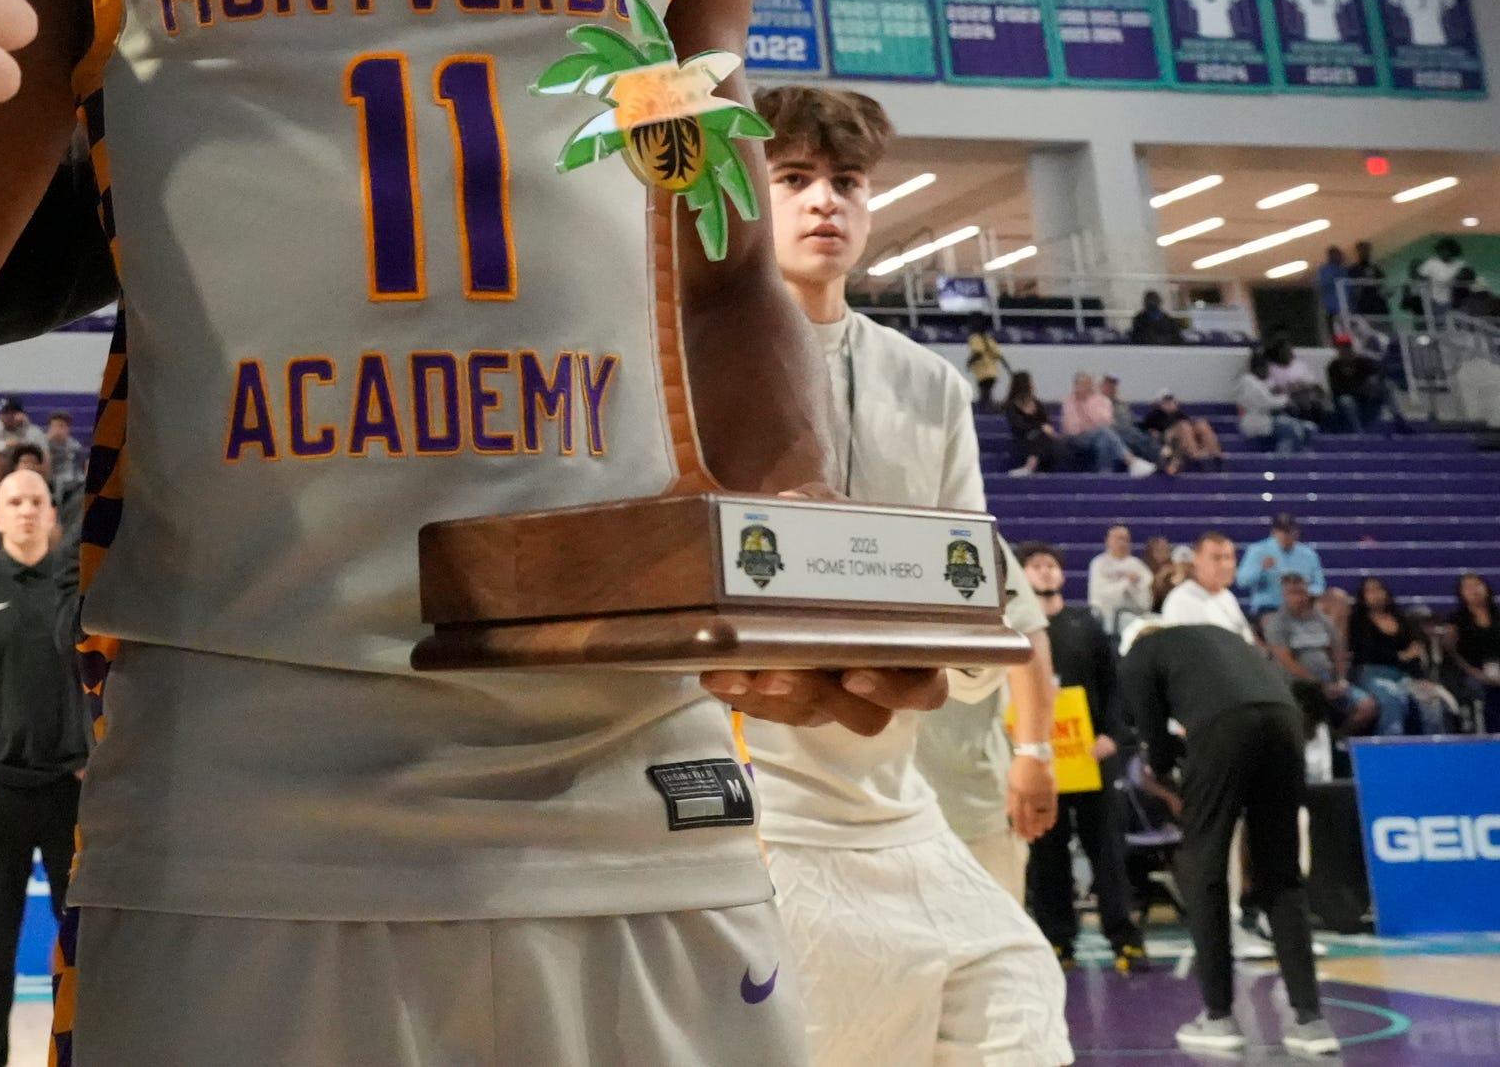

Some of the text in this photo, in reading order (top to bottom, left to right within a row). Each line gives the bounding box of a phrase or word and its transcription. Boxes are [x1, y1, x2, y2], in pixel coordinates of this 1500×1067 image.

[747, 34, 807, 61] 022
[343, 52, 518, 301] 11
[223, 349, 620, 465] ACADEMY
[850, 537, 879, 554] 2025
[806, 557, 924, 579] HOME TOWN HERO
[726, 778, 746, 803] M
